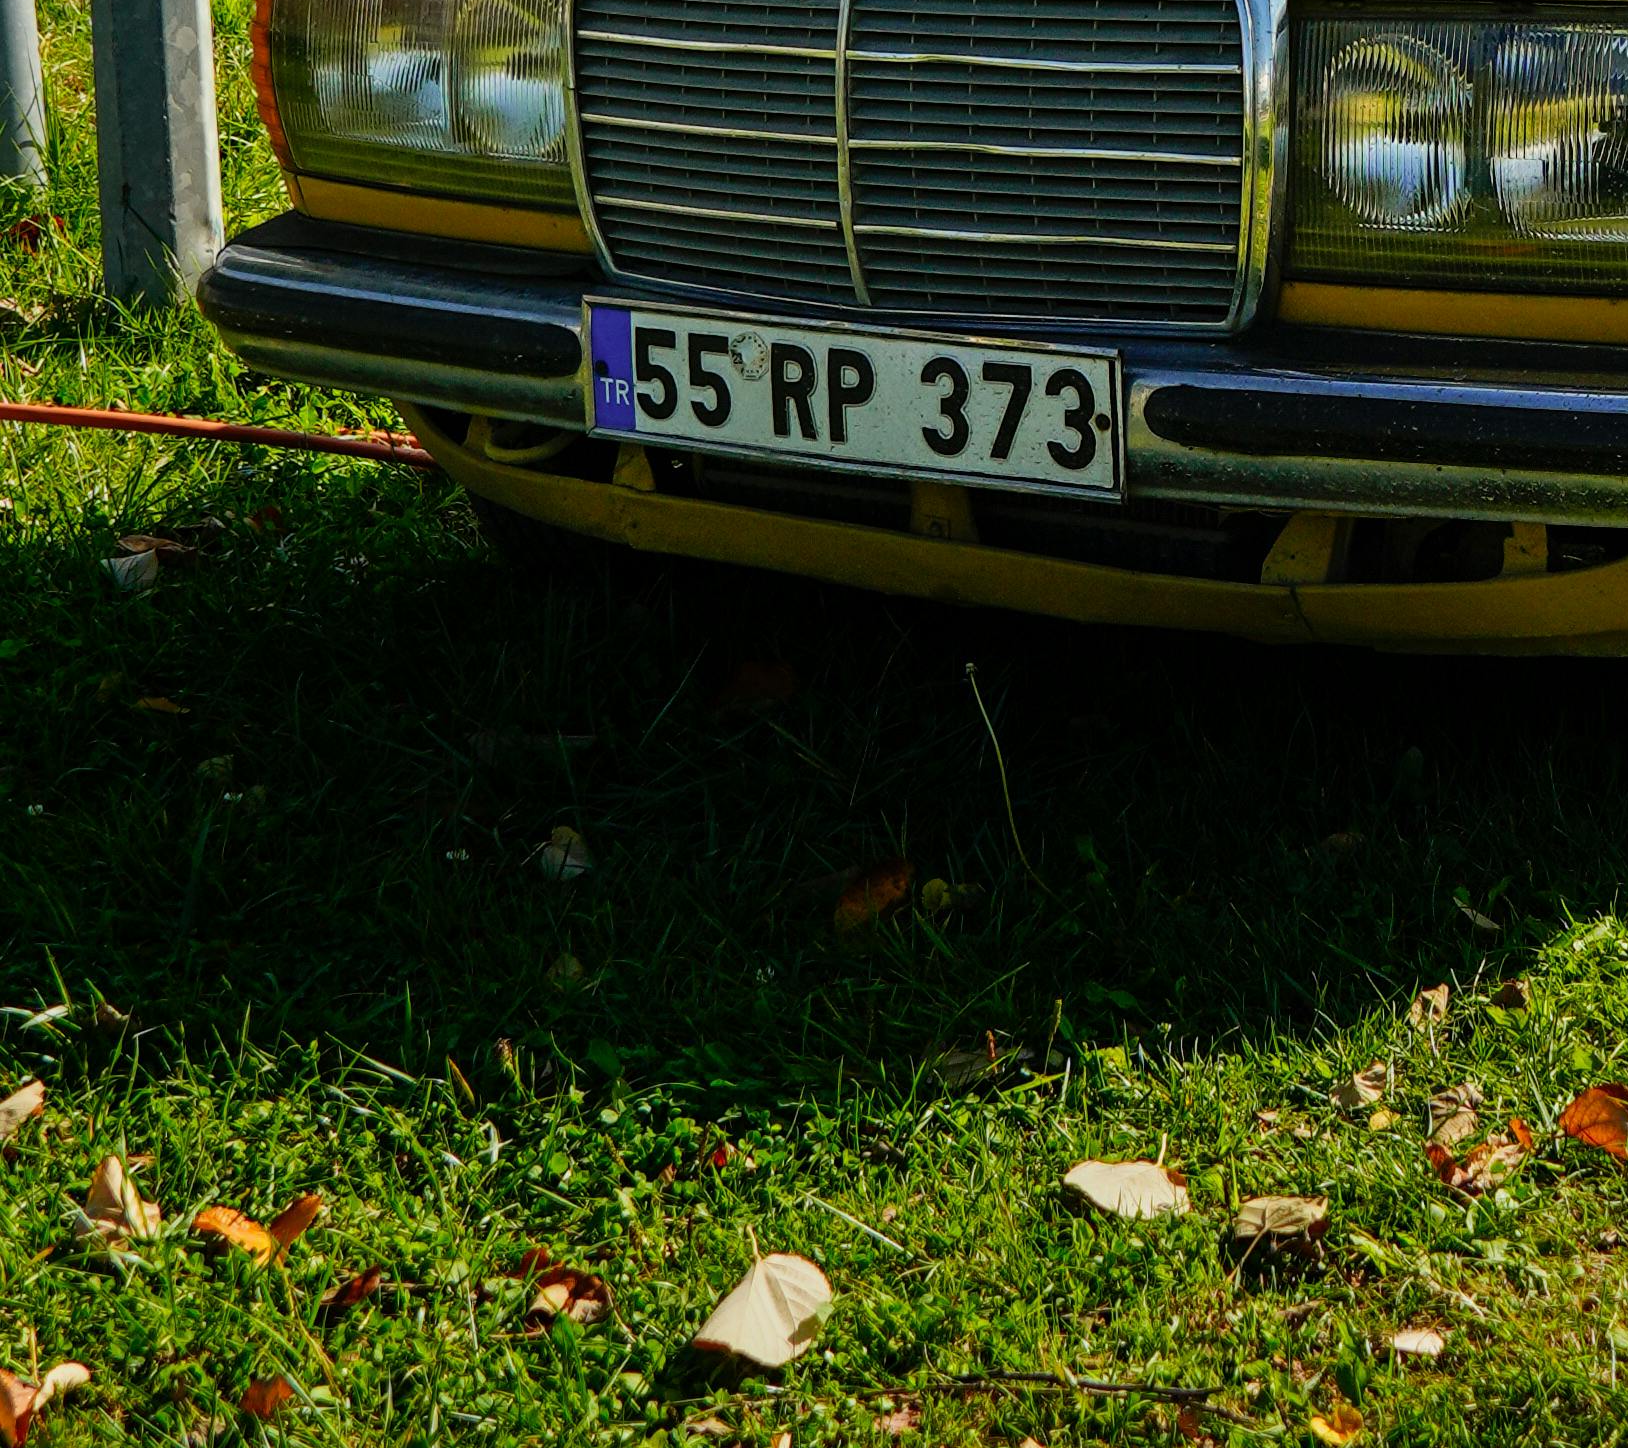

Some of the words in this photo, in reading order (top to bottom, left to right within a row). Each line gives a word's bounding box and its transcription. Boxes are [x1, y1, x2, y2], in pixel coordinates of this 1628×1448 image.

[600, 377, 629, 405] TR
[635, 326, 732, 428] 55
[770, 342, 876, 444] RP
[920, 356, 1097, 471] 373
